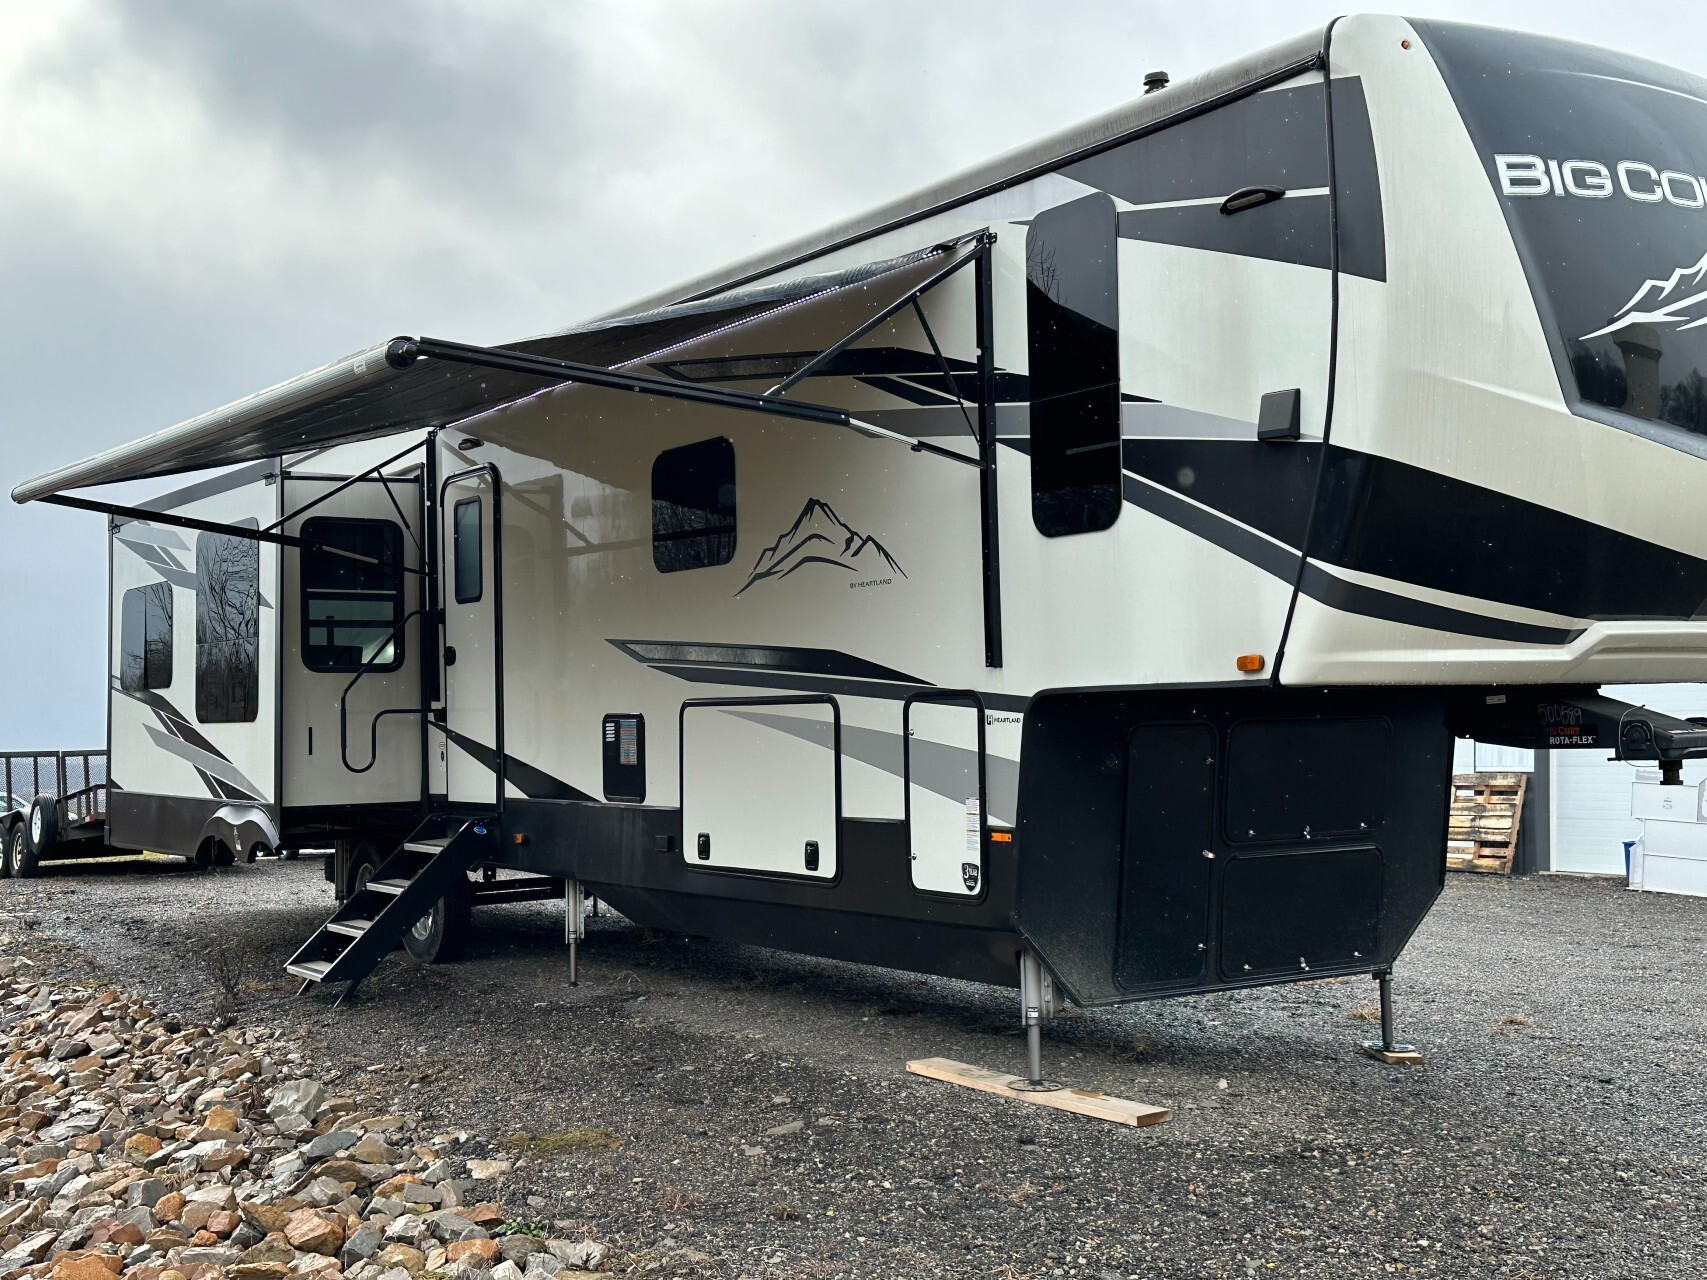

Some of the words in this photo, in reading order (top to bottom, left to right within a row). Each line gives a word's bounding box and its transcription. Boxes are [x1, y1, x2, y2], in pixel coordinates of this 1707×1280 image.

[1494, 153, 1614, 198] BIG
[1616, 159, 1707, 209] CO
[857, 578, 892, 588] HEARTLAND
[1537, 703, 1583, 725] 500589
[1557, 726, 1581, 735] CURT
[963, 864, 969, 878] 3
